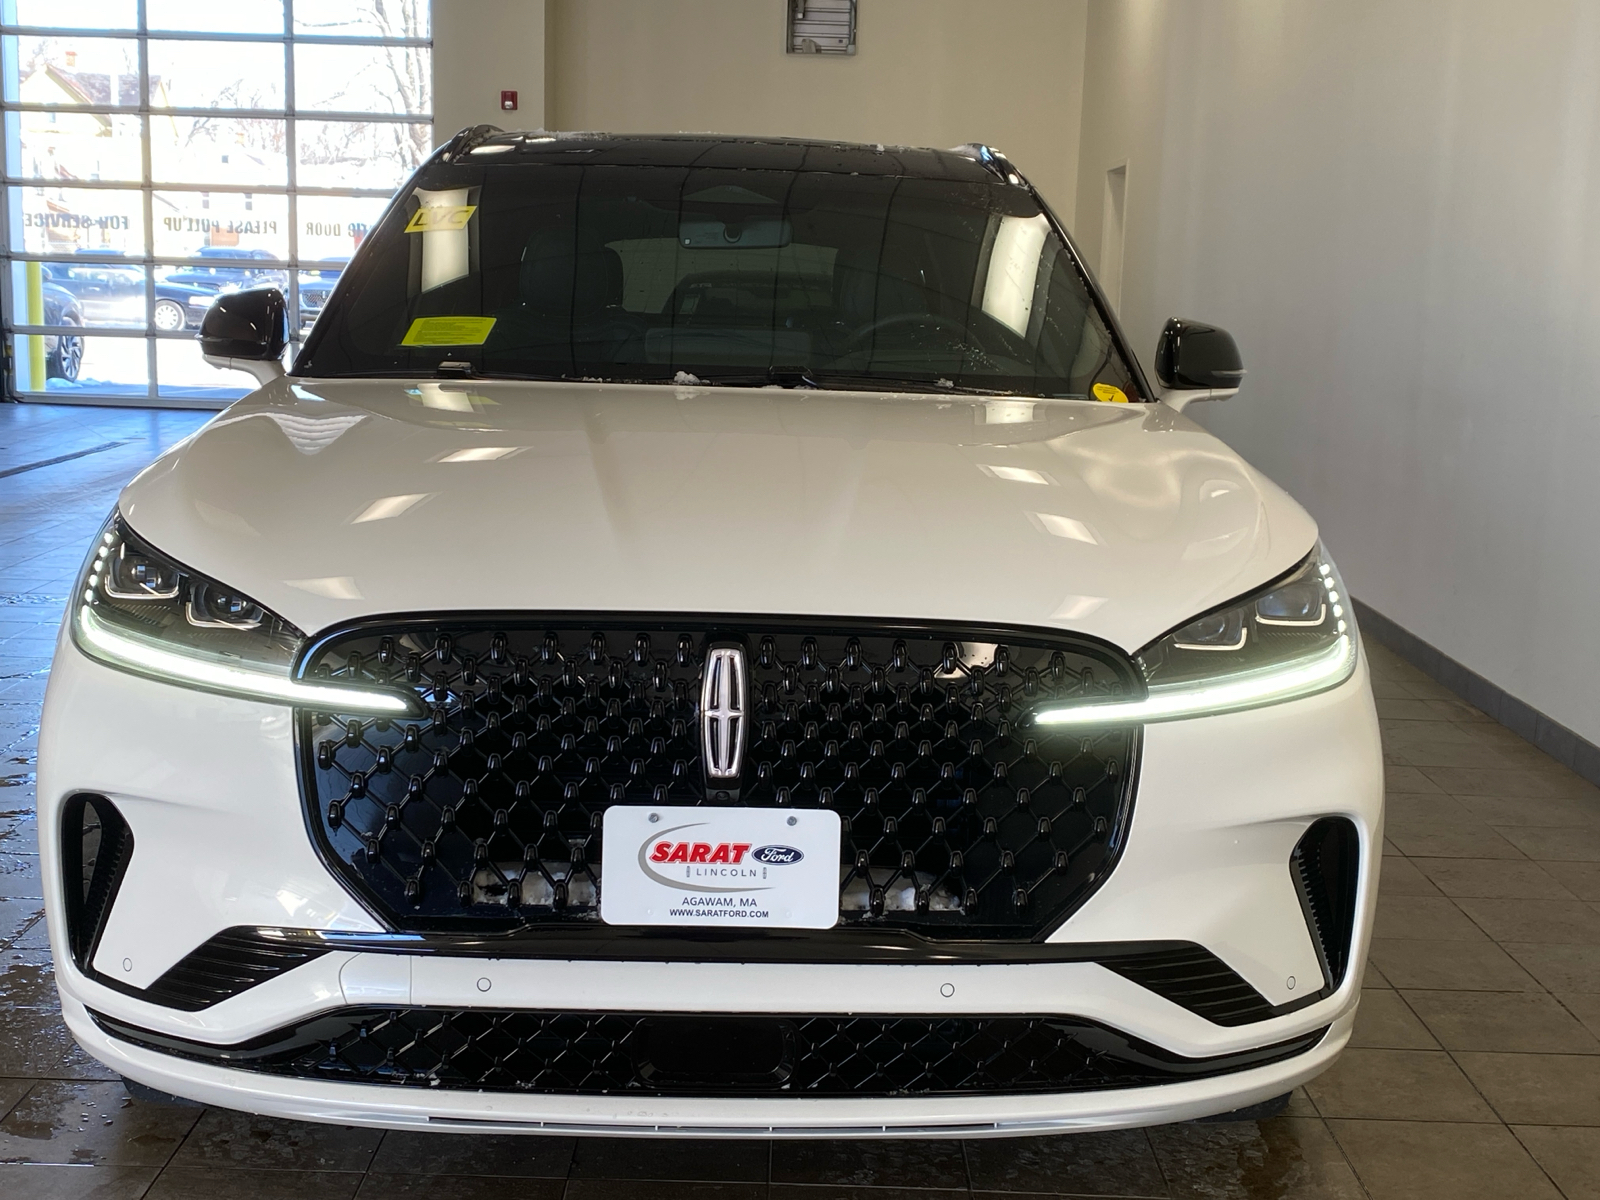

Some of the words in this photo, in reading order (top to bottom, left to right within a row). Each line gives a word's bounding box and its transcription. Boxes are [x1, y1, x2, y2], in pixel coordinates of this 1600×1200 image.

[649, 840, 753, 866] SARAT
[696, 867, 757, 878] LINCOLN
[682, 897, 736, 908] AGAWAM,
[739, 898, 758, 908] MA
[669, 908, 770, 919] WWW.SARATFORD.COM
